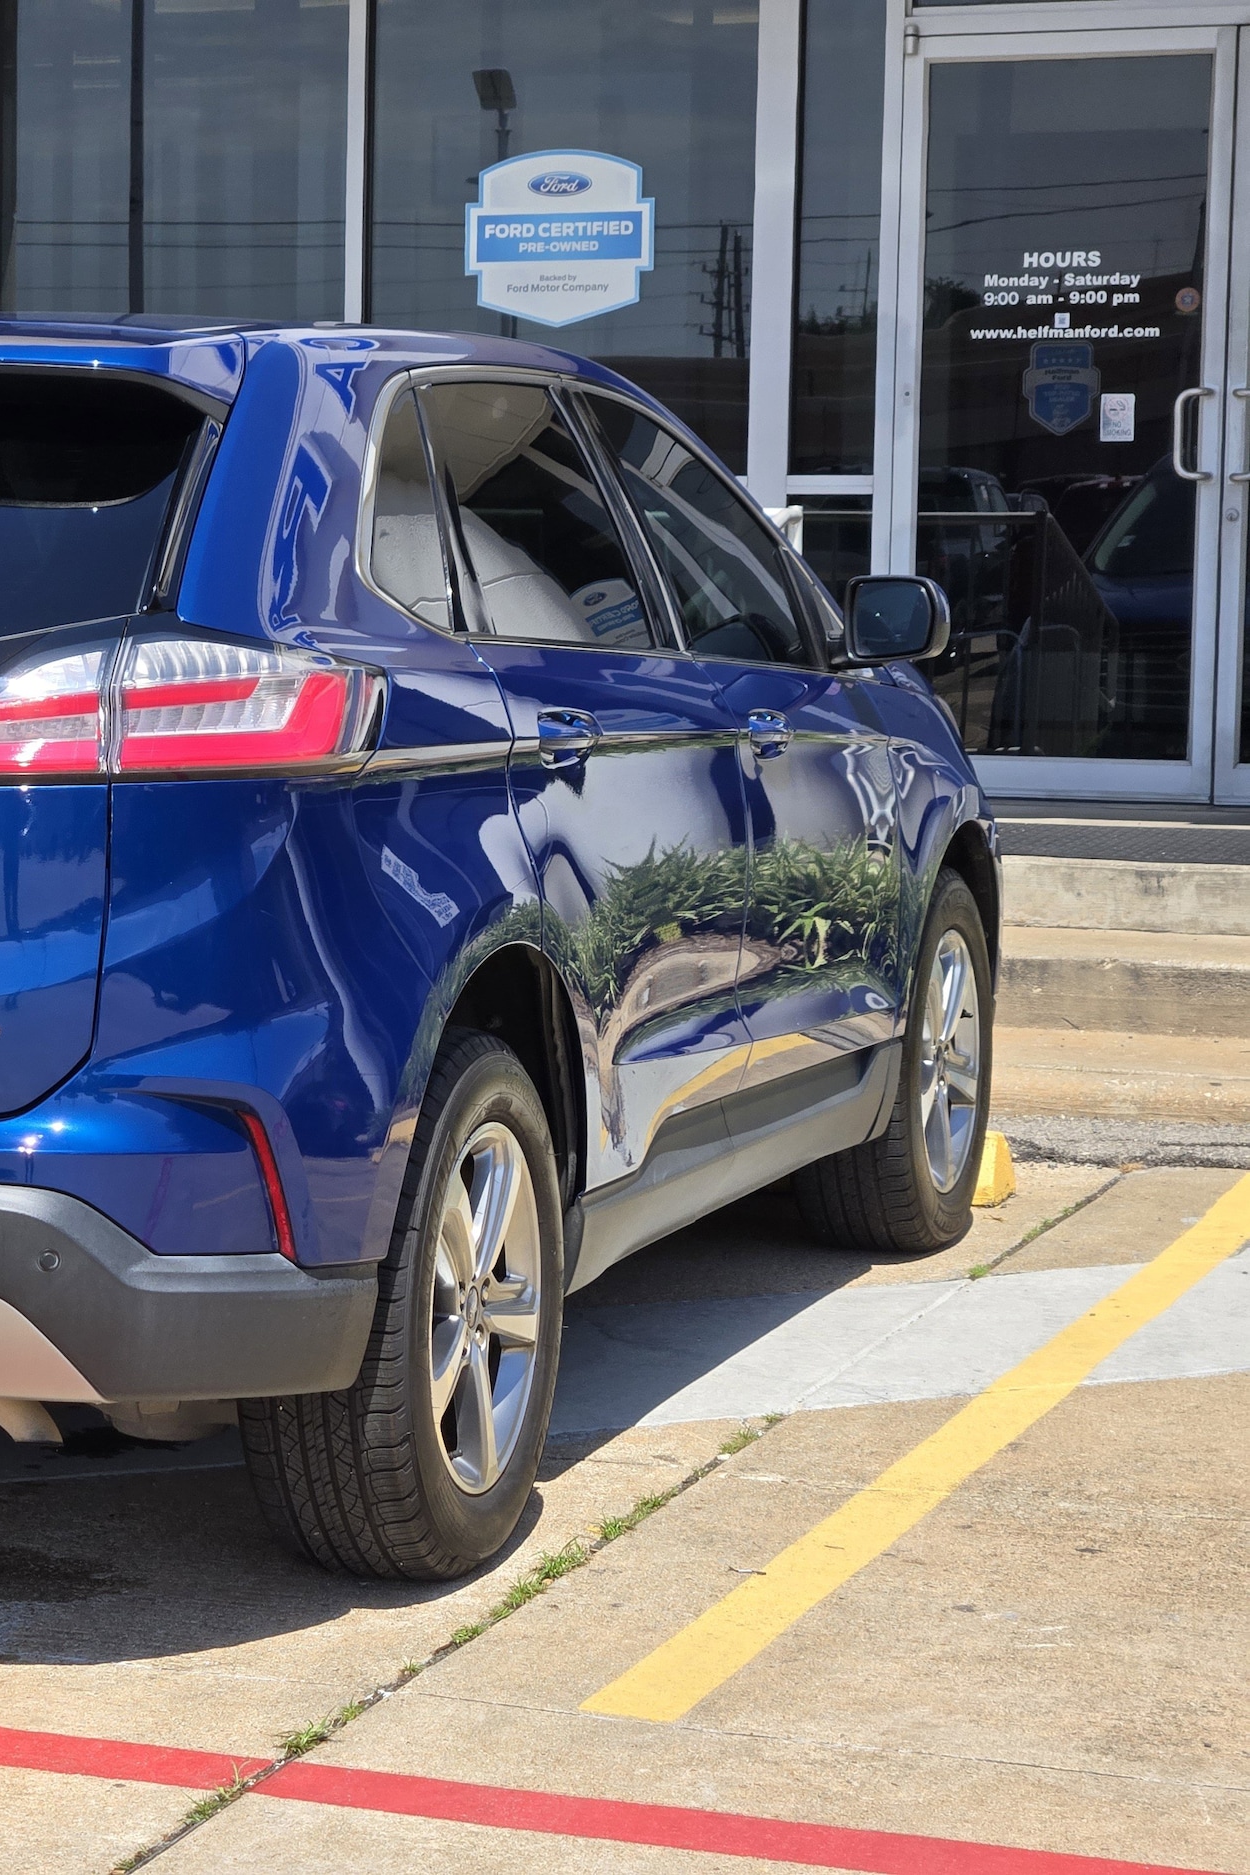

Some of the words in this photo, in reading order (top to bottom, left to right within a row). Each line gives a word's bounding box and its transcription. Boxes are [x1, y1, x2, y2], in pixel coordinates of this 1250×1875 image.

[539, 175, 579, 193] Ford
[484, 223, 535, 239] FORD
[538, 220, 634, 237] CERTIFIED
[518, 240, 599, 253] PRE-OWNED
[1022, 250, 1102, 268] HOURS
[539, 274, 566, 282] Backed
[567, 274, 577, 283] by
[984, 274, 1049, 289] Monday
[1063, 272, 1141, 288] Saturday
[506, 283, 529, 293] Ford
[530, 283, 560, 293] Motor
[561, 282, 609, 293] Company
[983, 292, 1020, 306] 9:00
[1025, 294, 1053, 305] am
[1069, 291, 1108, 305] 9:00
[1112, 292, 1140, 306] pm
[970, 325, 1161, 340] www.helfmanford.com
